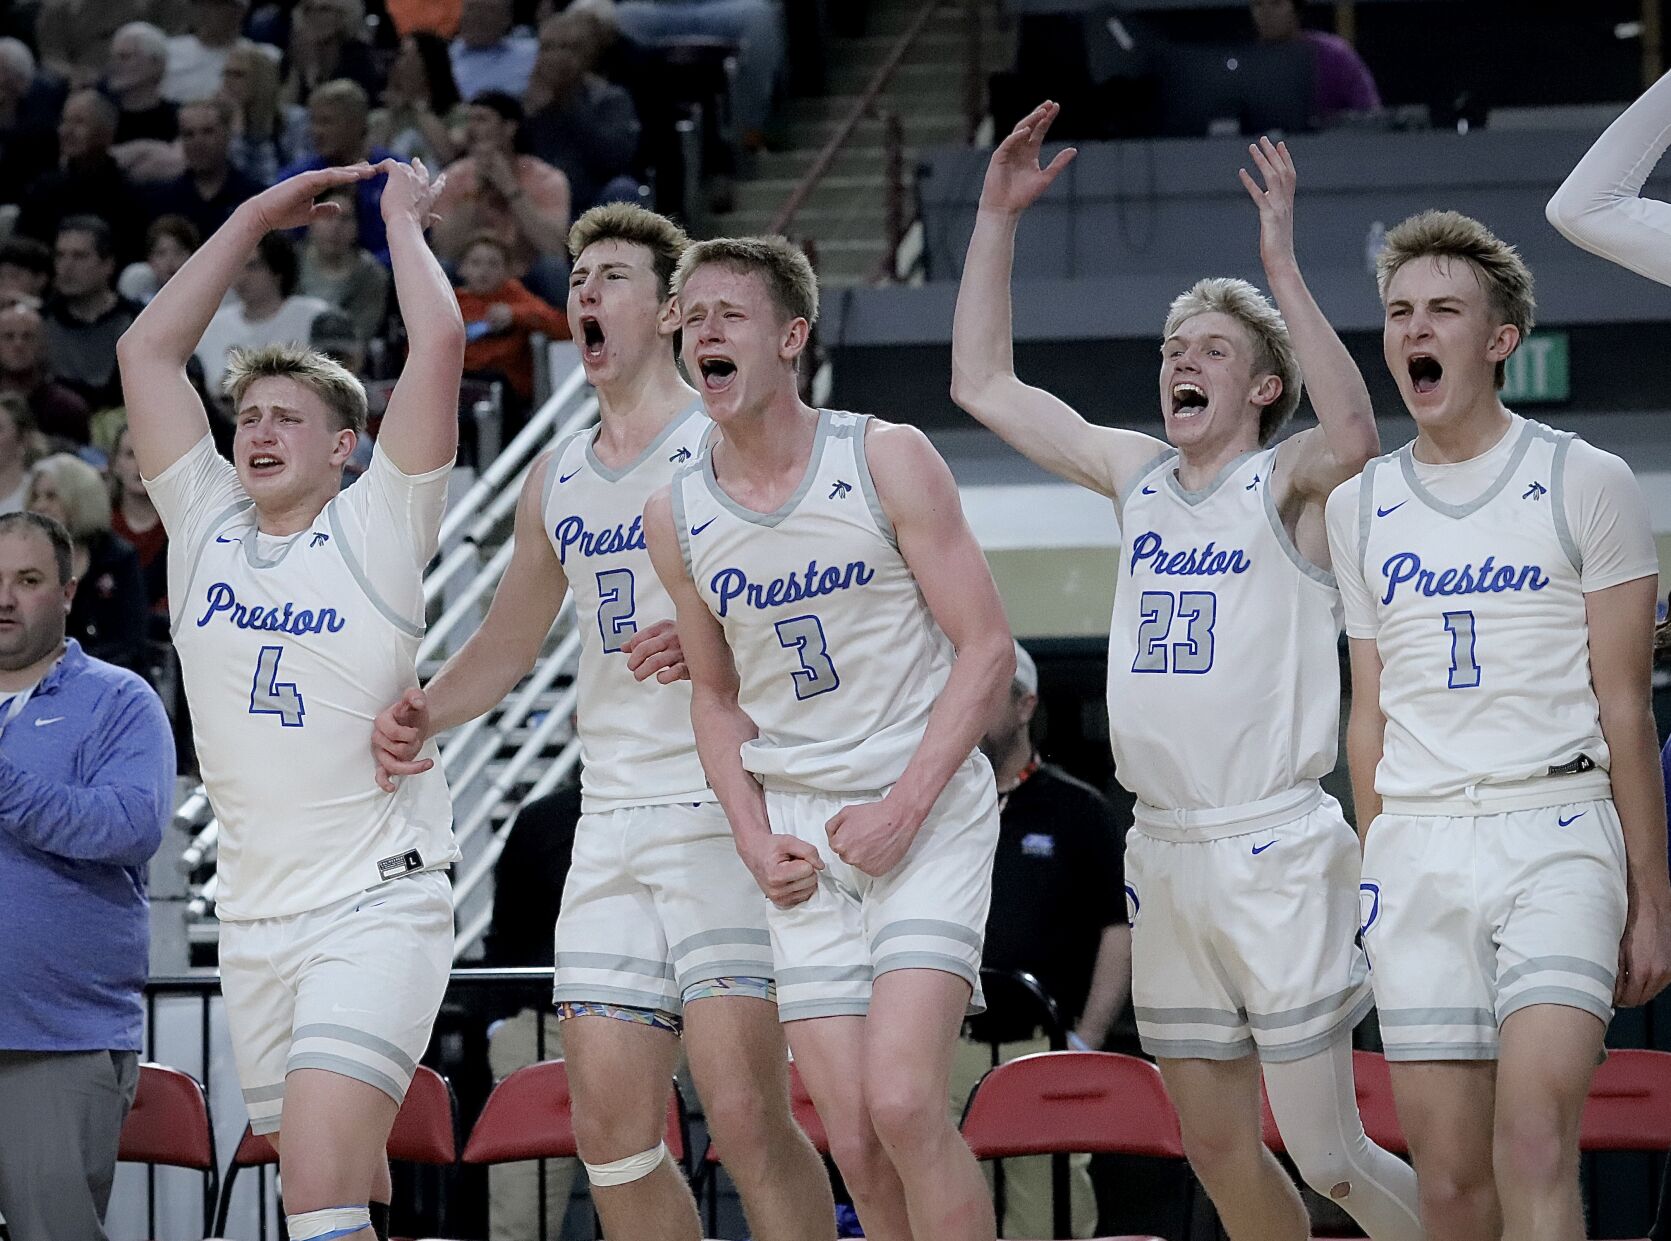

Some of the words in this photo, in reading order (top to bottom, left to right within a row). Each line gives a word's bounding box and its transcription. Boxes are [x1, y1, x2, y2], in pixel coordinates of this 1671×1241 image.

[1504, 337, 1553, 396] IT
[555, 515, 647, 566] Prest
[1131, 531, 1251, 578] Preston
[710, 560, 875, 618] Preston
[1381, 552, 1550, 606] Preston
[197, 582, 345, 636] Preston
[595, 567, 638, 654] 2
[1131, 591, 1217, 674] 23
[774, 614, 840, 701] 3
[1441, 610, 1481, 689] 1
[249, 645, 306, 727] 4
[409, 857, 417, 866] L
